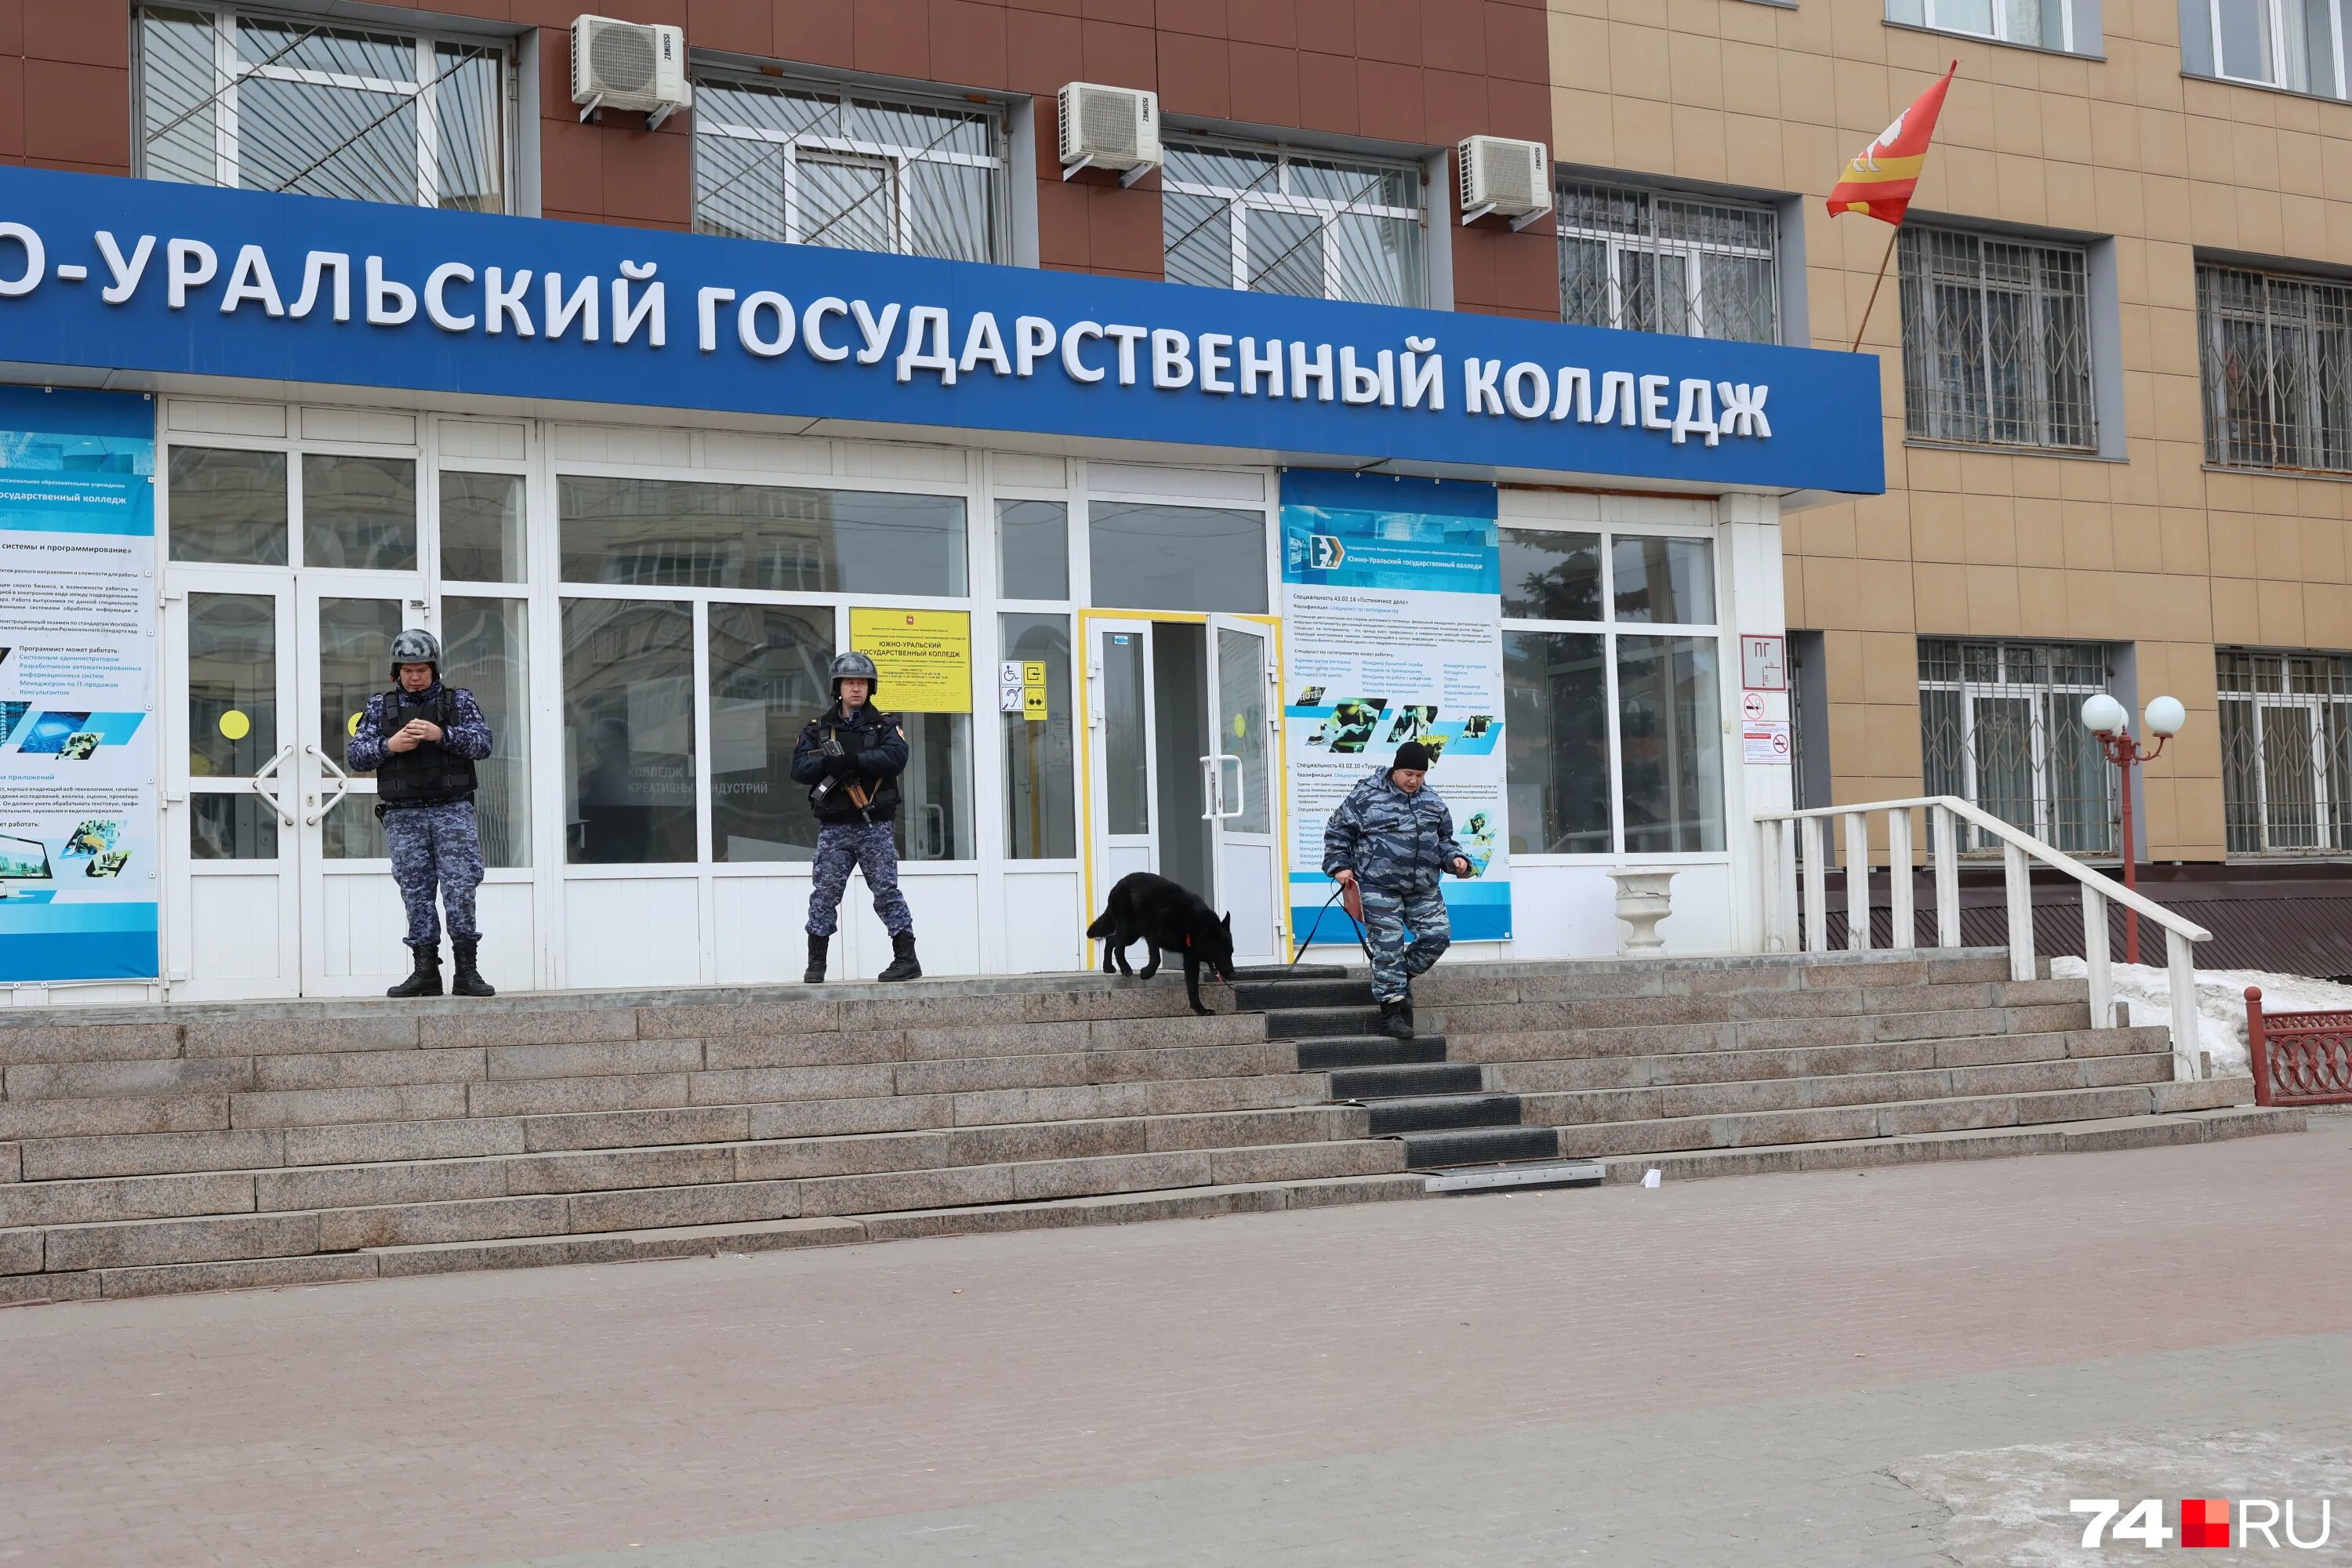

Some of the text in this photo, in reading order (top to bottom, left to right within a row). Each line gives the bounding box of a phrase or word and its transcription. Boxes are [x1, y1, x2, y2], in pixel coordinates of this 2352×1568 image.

[699, 286, 1444, 411] ГОСУДАРСТВЕННЫЙ
[1465, 357, 1771, 447] КОЛЛЕДЖ
[1755, 642, 1769, 657] ПГ
[628, 781, 768, 793] КРЕАТИВНЫ НДУСТРИЙ
